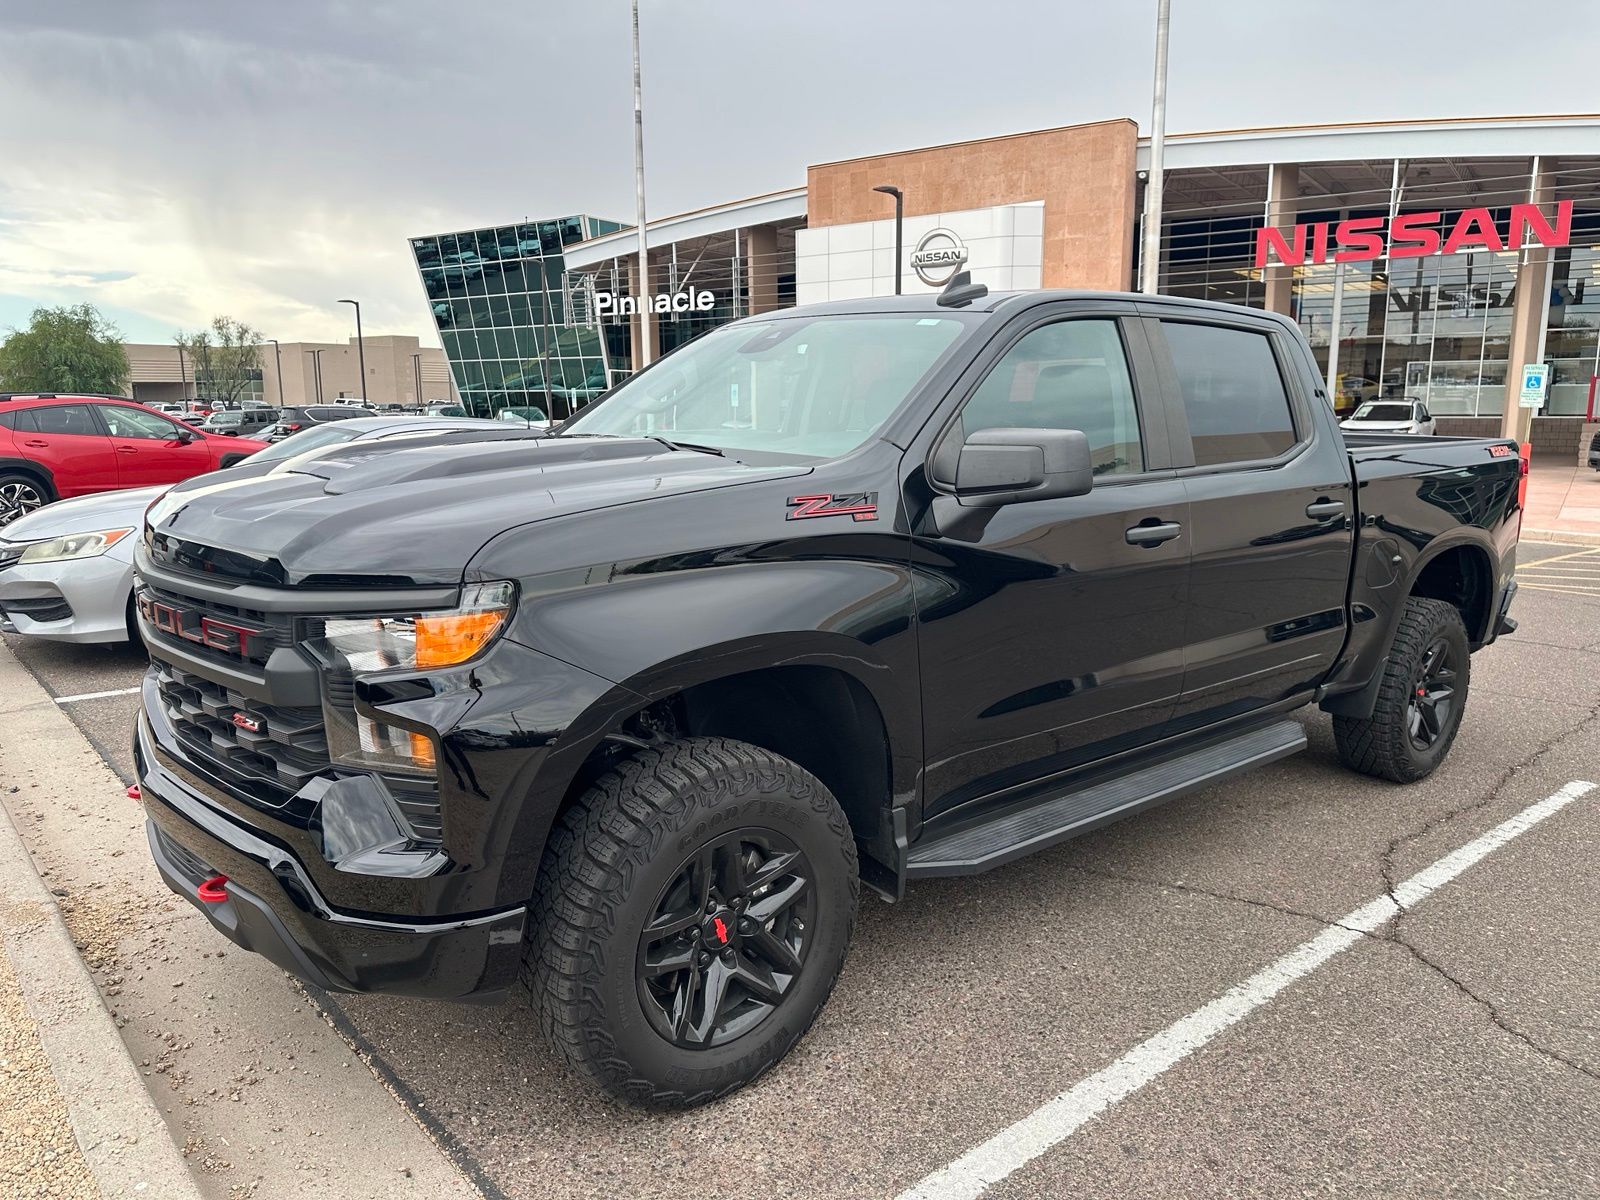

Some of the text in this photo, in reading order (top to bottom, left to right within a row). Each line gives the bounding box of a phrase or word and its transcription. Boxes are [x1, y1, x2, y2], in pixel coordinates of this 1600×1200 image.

[1255, 200, 1573, 267] NISSAN
[914, 250, 961, 263] NISSAN
[595, 286, 715, 316] Pinnacle
[786, 491, 879, 521] Z71
